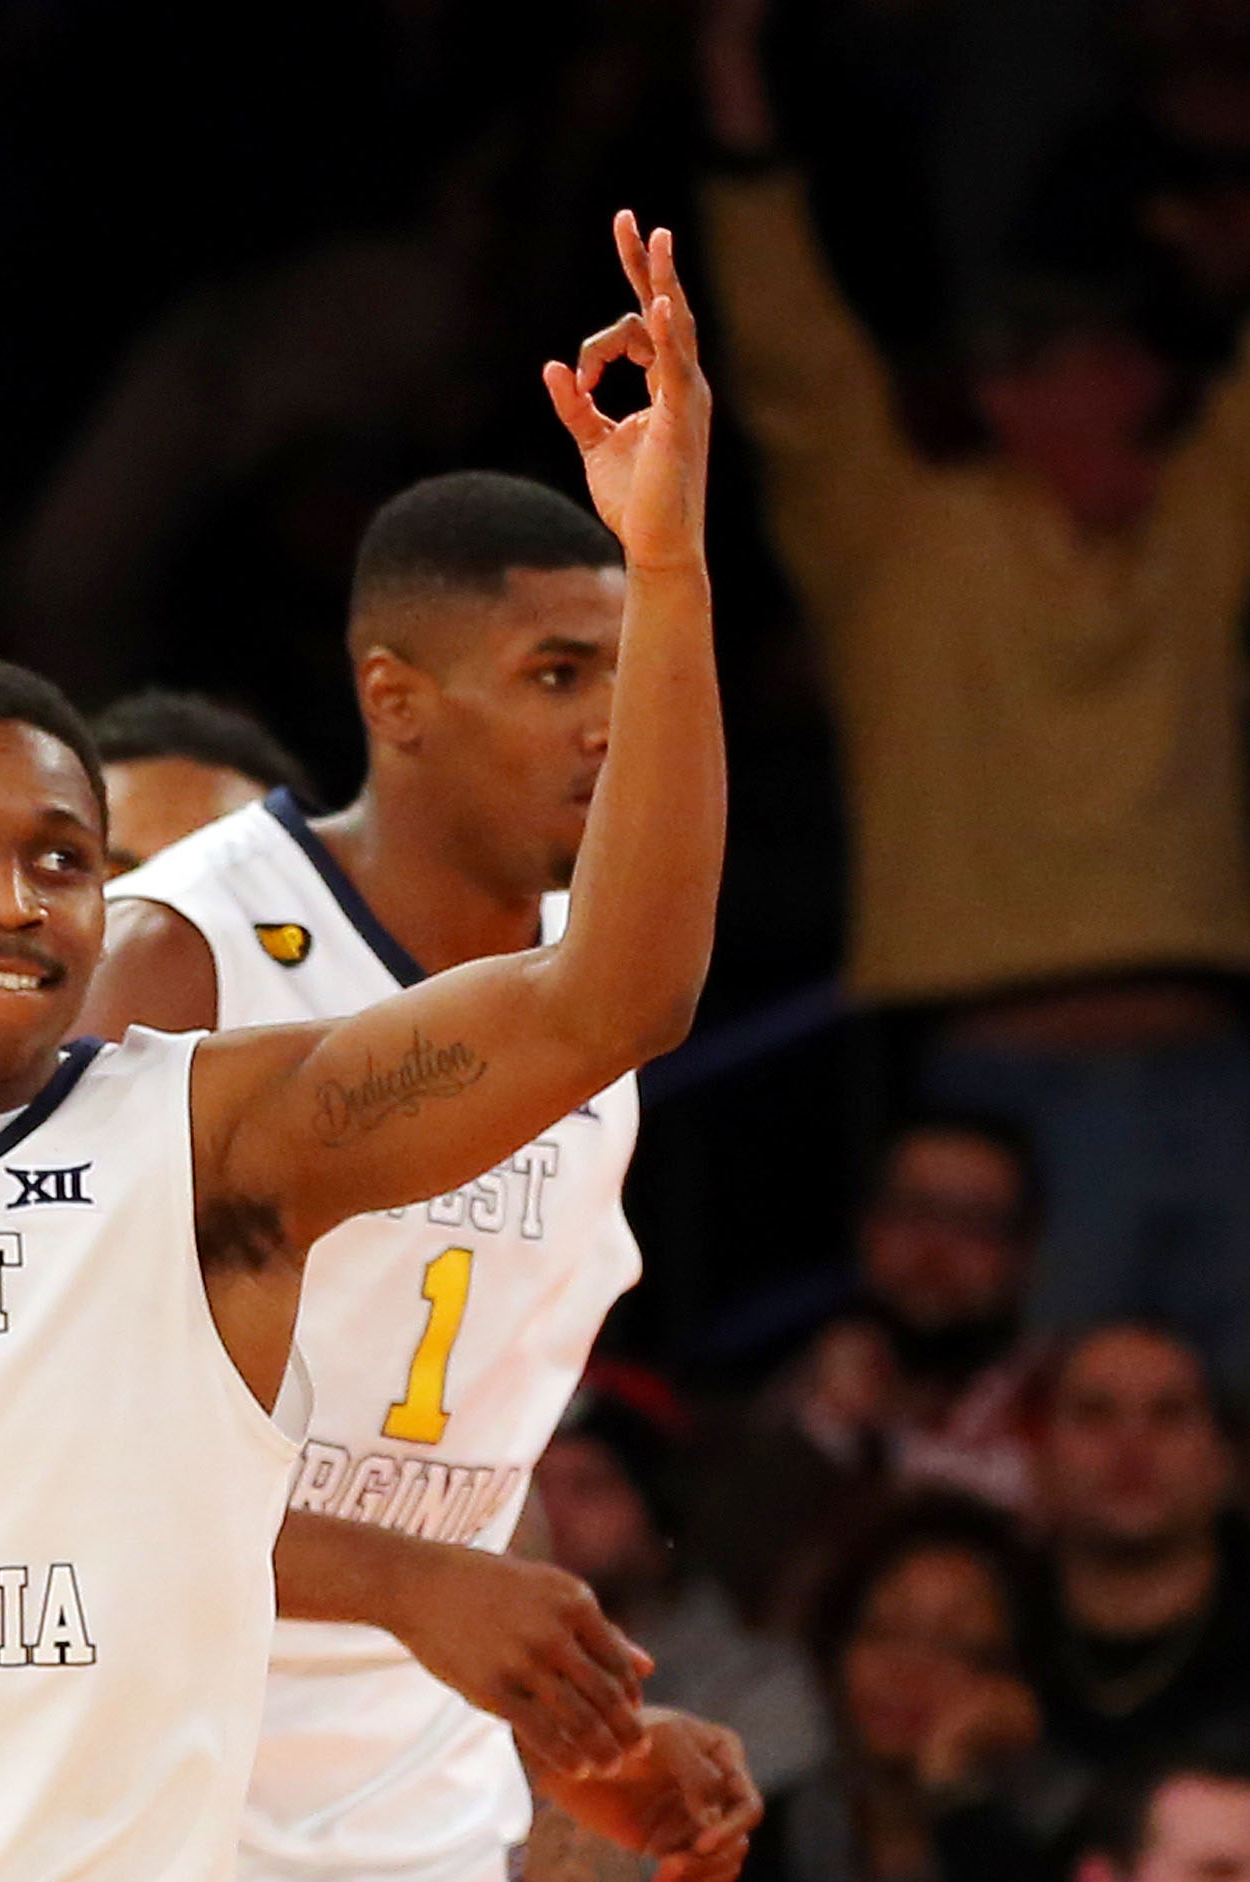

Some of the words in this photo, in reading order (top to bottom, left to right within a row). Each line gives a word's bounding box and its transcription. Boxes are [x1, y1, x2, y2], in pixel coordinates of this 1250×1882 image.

[313, 1024, 487, 1147] Dedication
[5, 1162, 94, 1209] XII
[381, 1247, 474, 1445] 1
